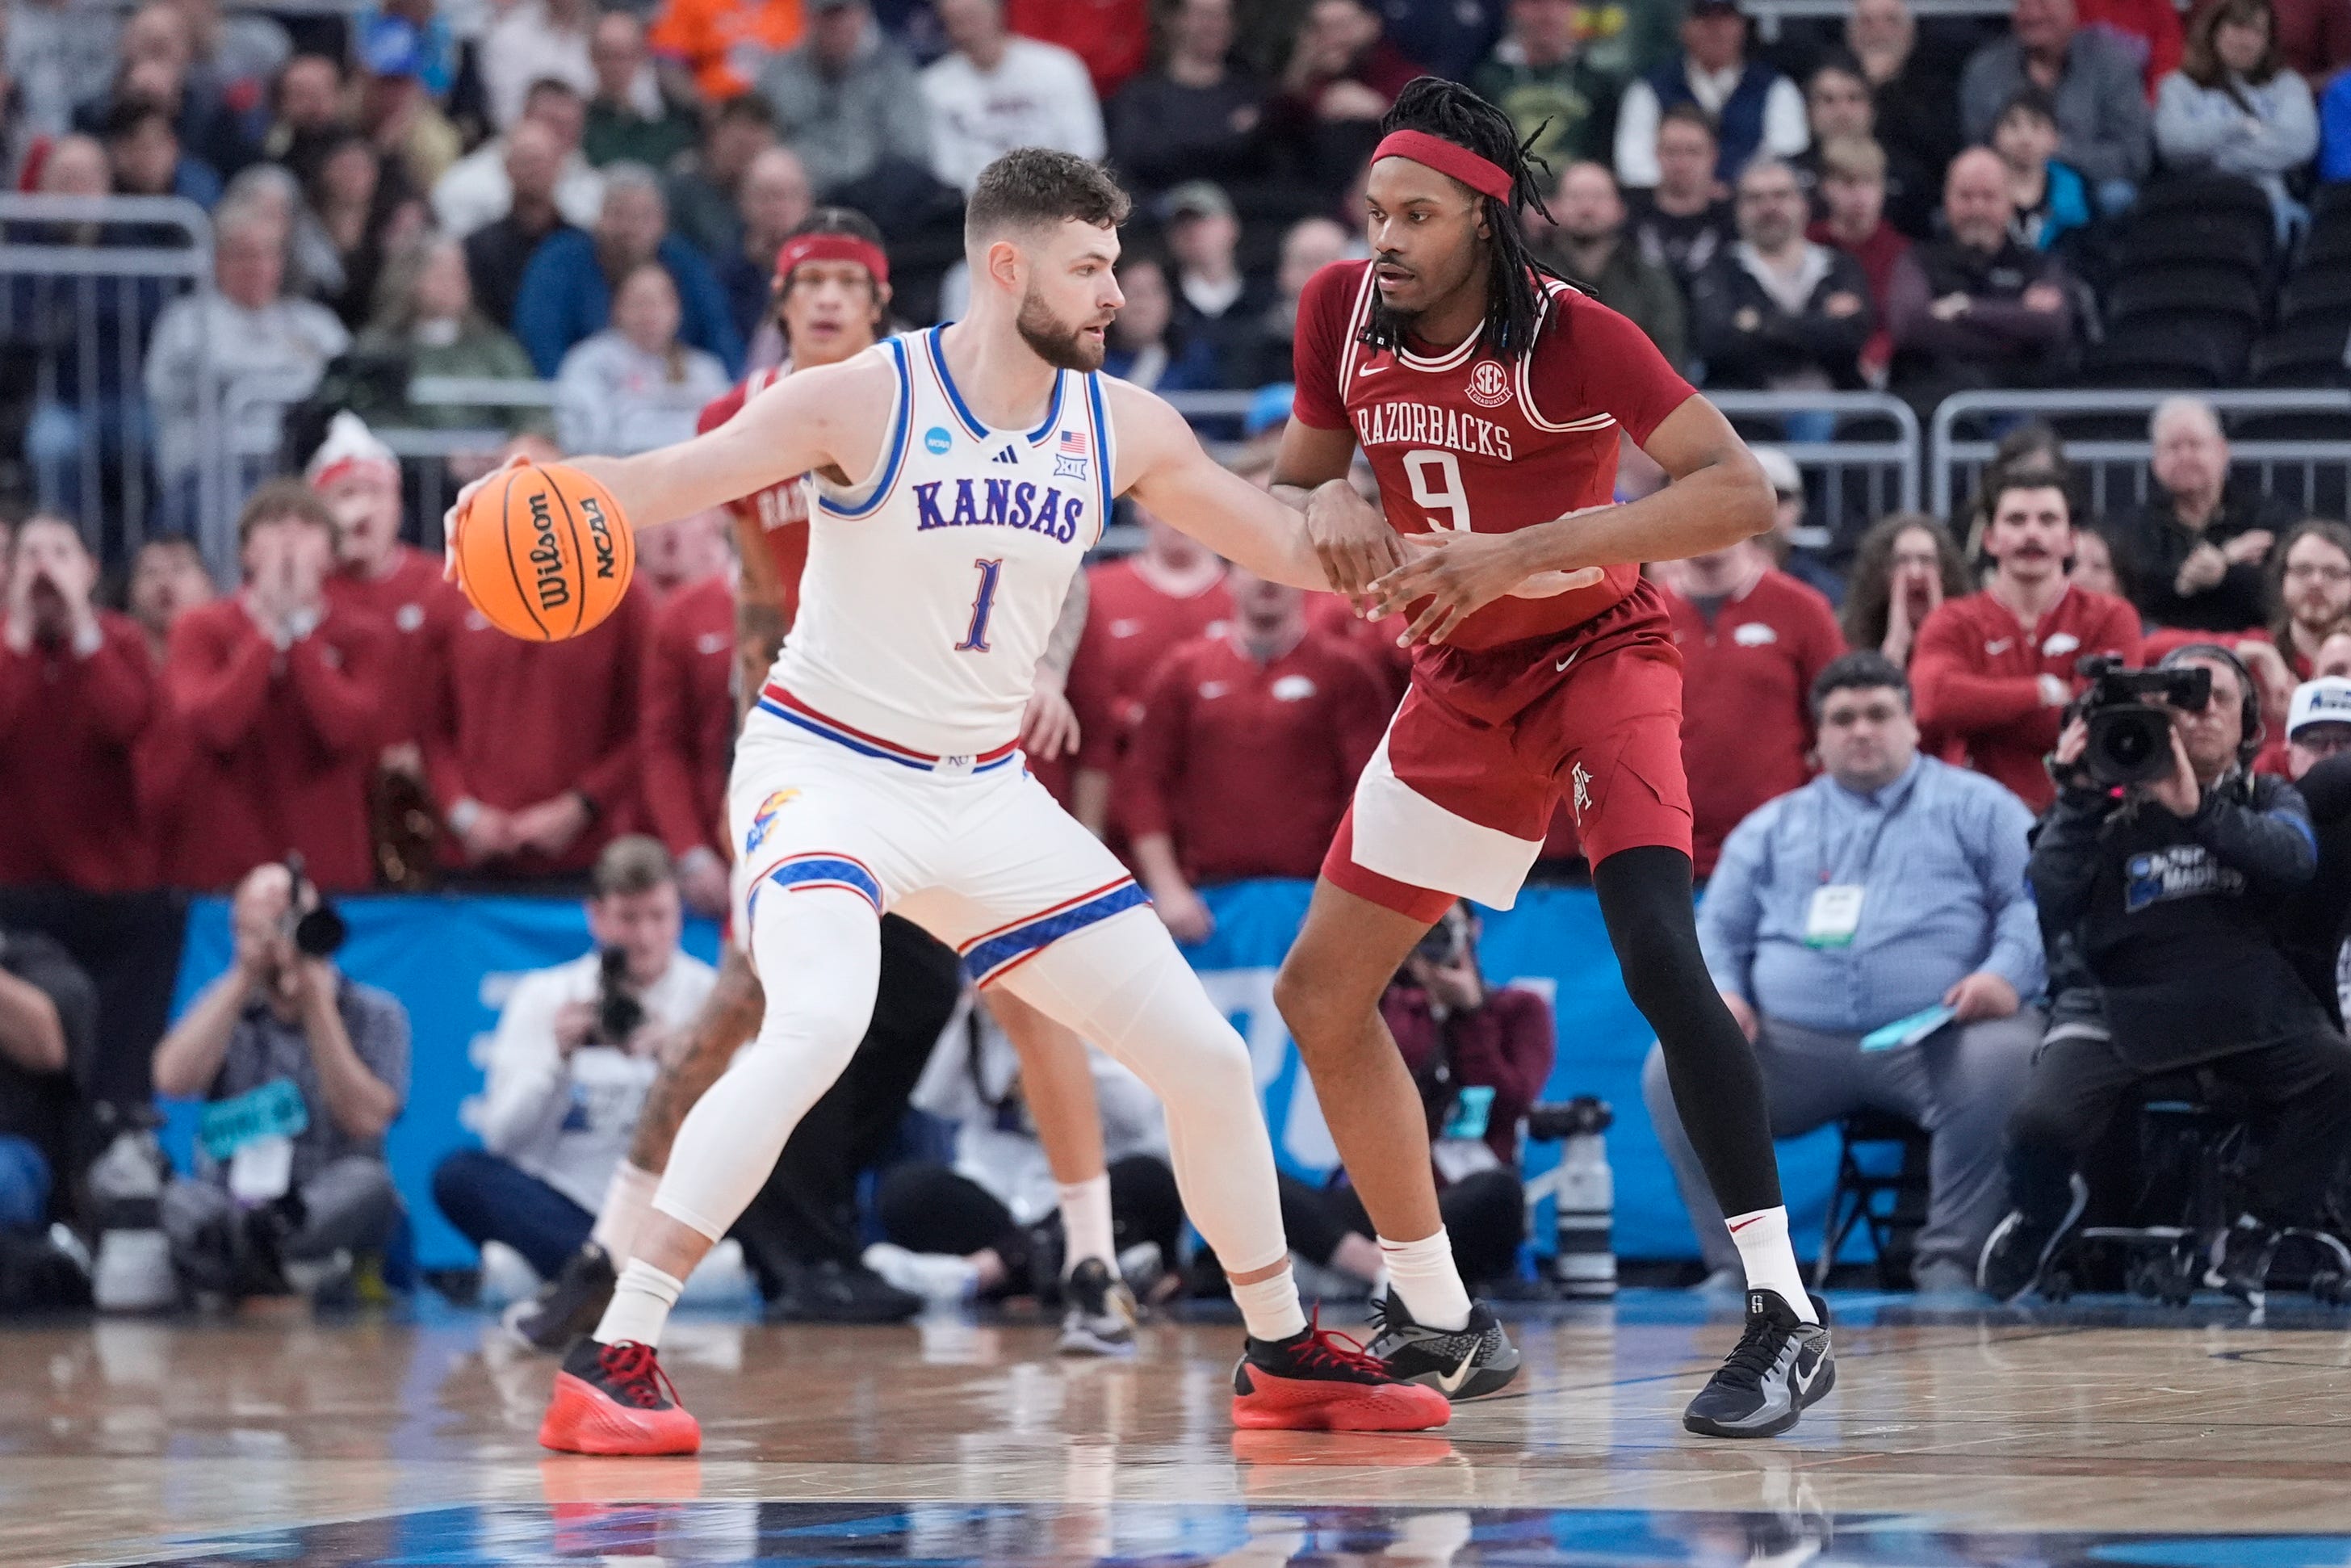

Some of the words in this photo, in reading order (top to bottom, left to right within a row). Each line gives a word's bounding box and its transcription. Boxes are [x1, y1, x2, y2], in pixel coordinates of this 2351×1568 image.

[1472, 392, 1505, 405] GRADUATE
[1475, 364, 1502, 394] SEC
[1356, 401, 1513, 462] RAZORBACKS
[912, 478, 1084, 544] KANSAS
[1402, 449, 1472, 534] 9
[529, 489, 570, 611] Wilson
[580, 497, 615, 579] NCAA
[954, 558, 1003, 652] 1
